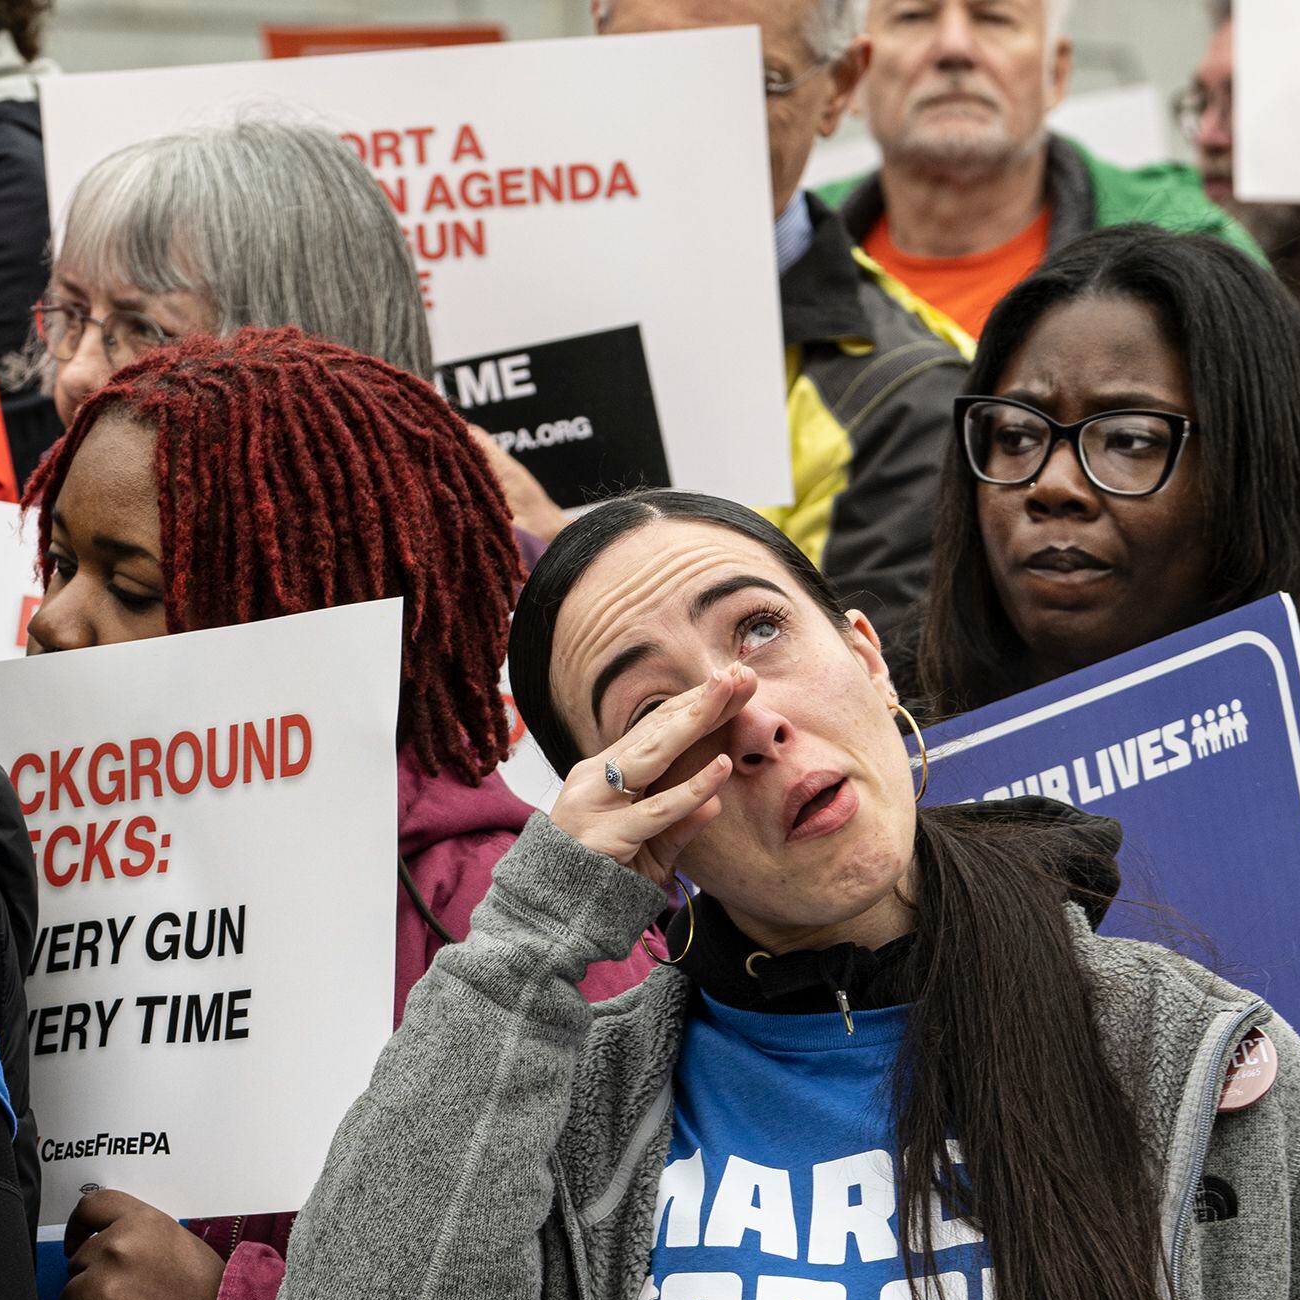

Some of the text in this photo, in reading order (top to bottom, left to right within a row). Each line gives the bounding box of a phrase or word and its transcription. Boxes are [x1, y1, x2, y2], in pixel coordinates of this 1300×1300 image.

[450, 123, 486, 165] A
[423, 160, 640, 214] AGENDA
[403, 218, 488, 262] UN
[454, 353, 538, 410] ME
[1072, 718, 1193, 806] LIVES
[144, 904, 247, 963] GUN
[135, 988, 253, 1044] TIME
